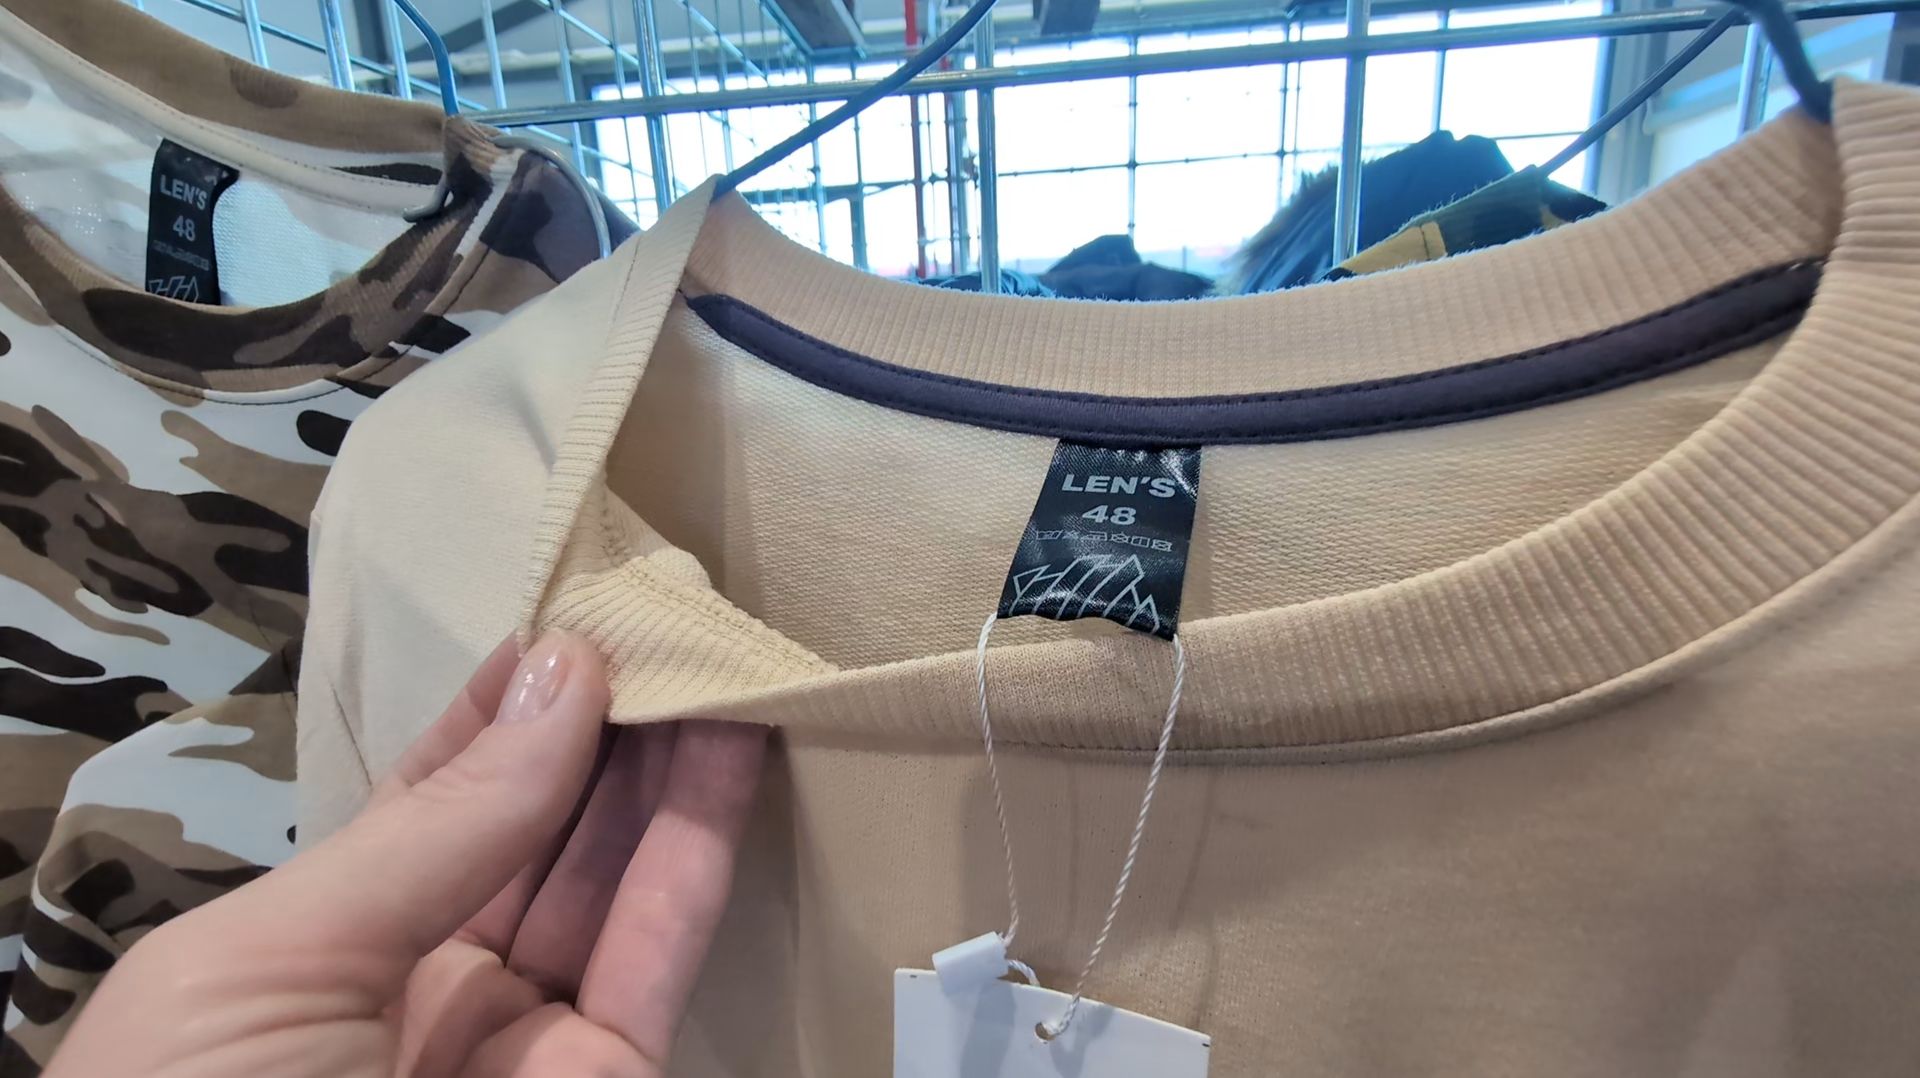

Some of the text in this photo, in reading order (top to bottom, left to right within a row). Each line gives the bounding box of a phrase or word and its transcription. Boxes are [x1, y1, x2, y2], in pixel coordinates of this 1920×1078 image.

[160, 174, 207, 210] LEN'S
[173, 215, 195, 241] 48
[1062, 474, 1176, 498] LEN'S
[1082, 505, 1136, 525] 48
